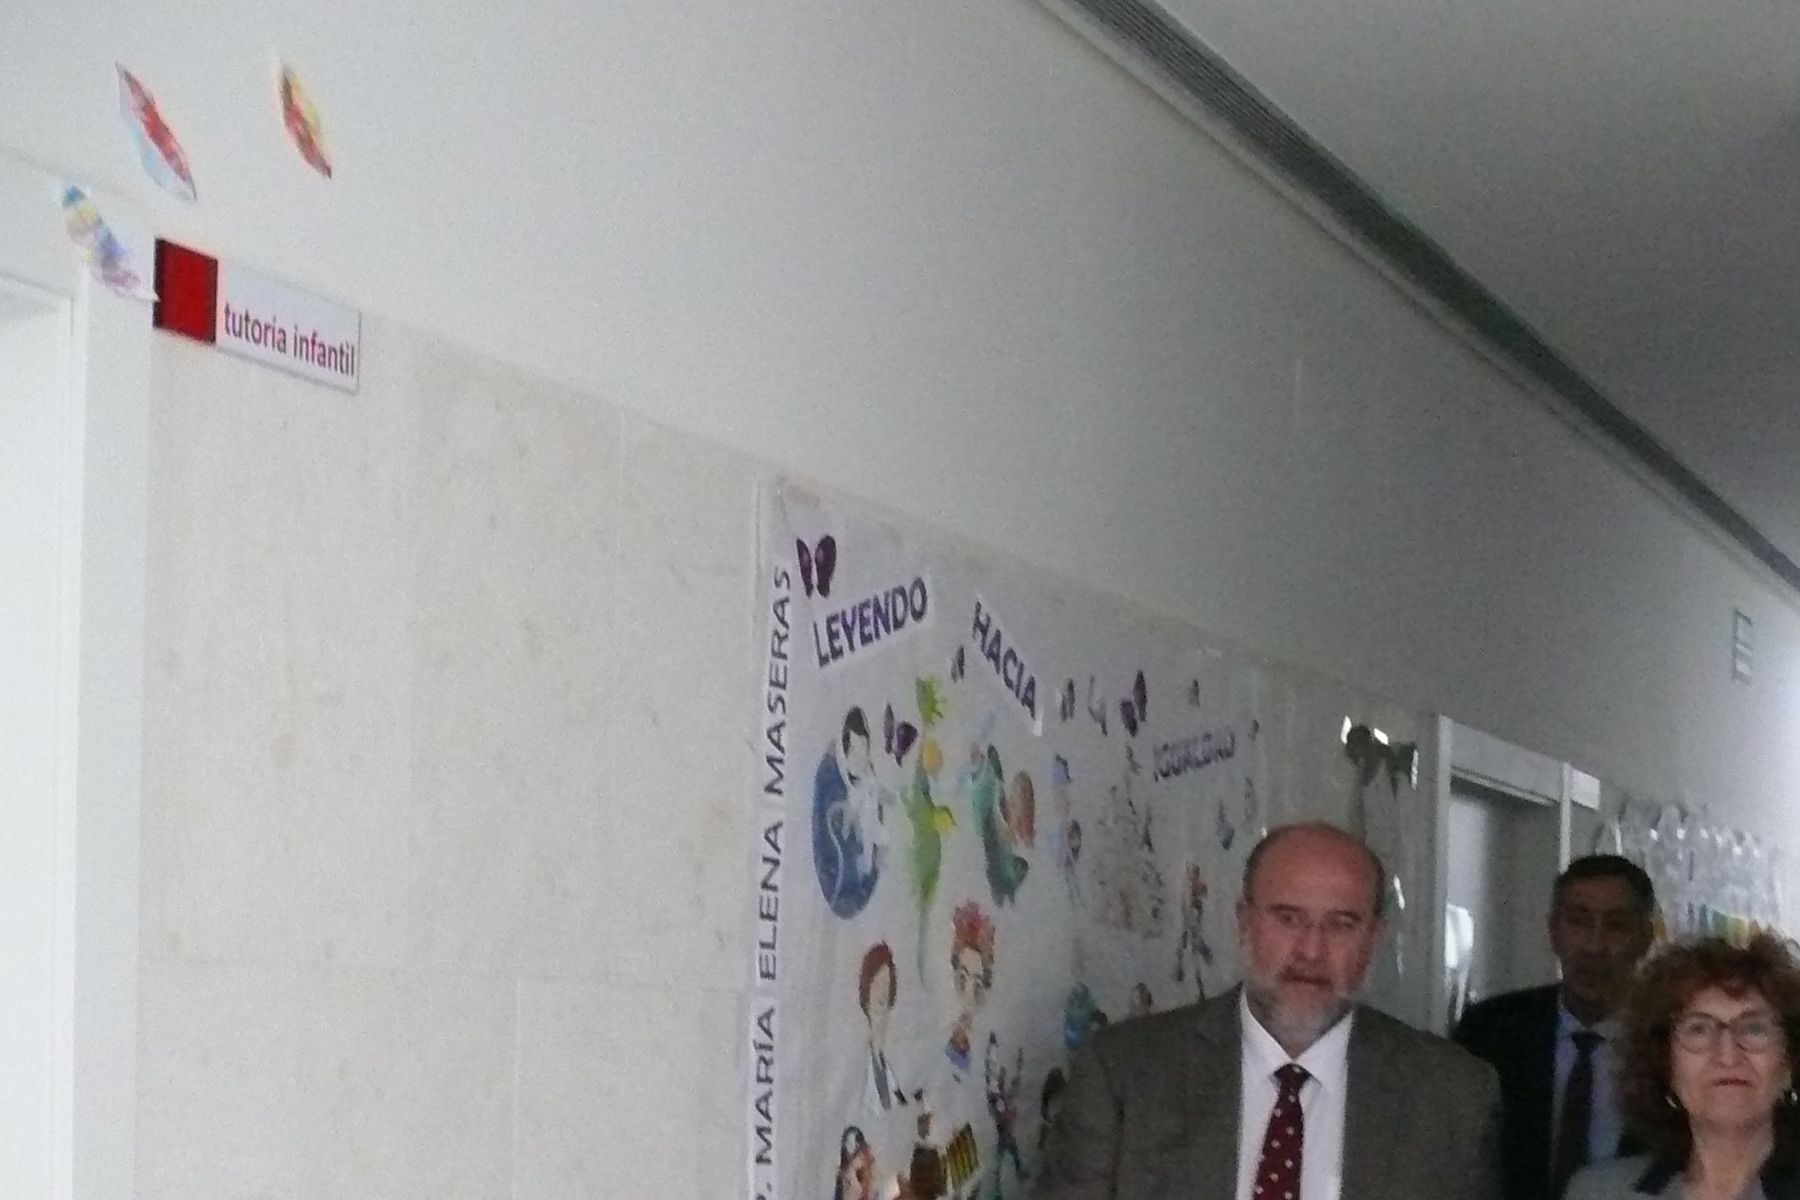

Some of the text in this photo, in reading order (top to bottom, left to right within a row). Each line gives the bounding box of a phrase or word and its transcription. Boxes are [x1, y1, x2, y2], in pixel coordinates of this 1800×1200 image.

[293, 323, 355, 377] infantil
[764, 565, 791, 797] MASERAS
[812, 576, 928, 668] LEYENDO
[971, 600, 1038, 719] HACIA
[757, 819, 784, 981] ELENA
[752, 1006, 776, 1167] MARÍA
